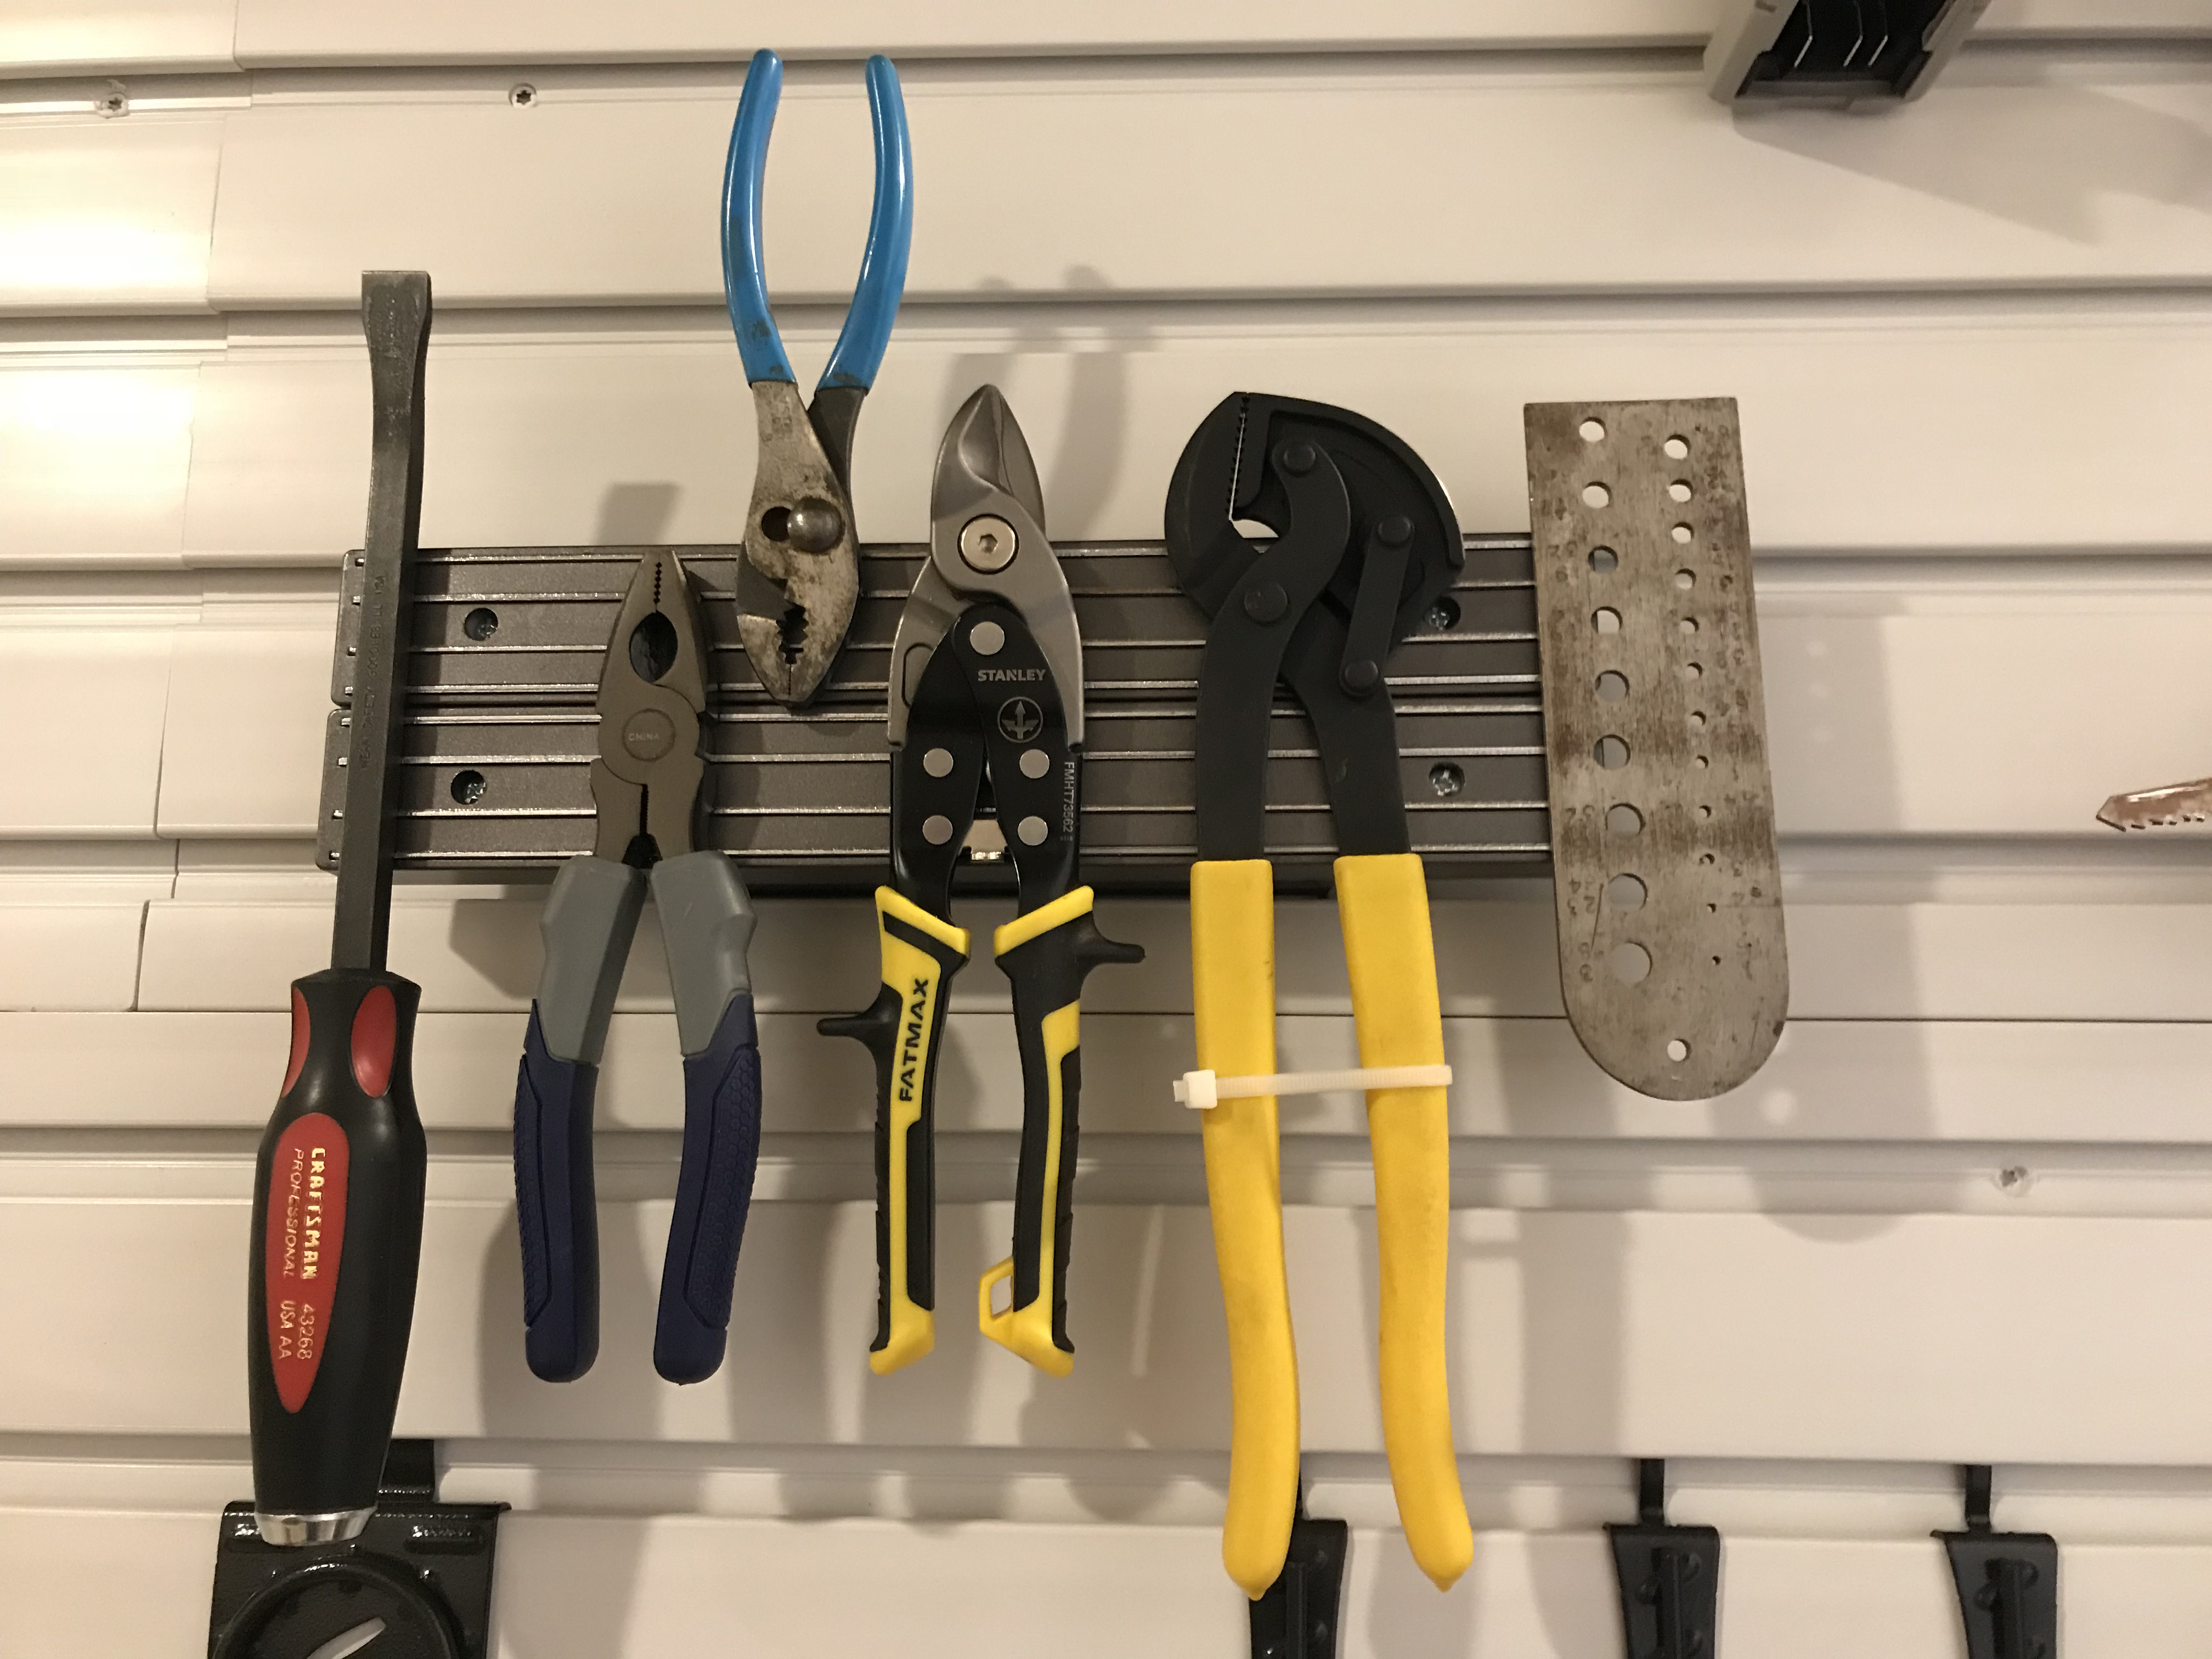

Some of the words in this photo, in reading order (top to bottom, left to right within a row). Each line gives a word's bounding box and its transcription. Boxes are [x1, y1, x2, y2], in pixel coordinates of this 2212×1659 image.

[977, 669, 1046, 682] STANLEY
[1063, 761, 1075, 833] FMHT73562
[899, 978, 929, 1102] FATMAX
[283, 1147, 305, 1278] PROFESSIONAL
[301, 1147, 326, 1280] CRAFTSMAN
[279, 1299, 297, 1329] USA
[296, 1304, 315, 1361] 43268
[278, 1335, 292, 1361] AA
